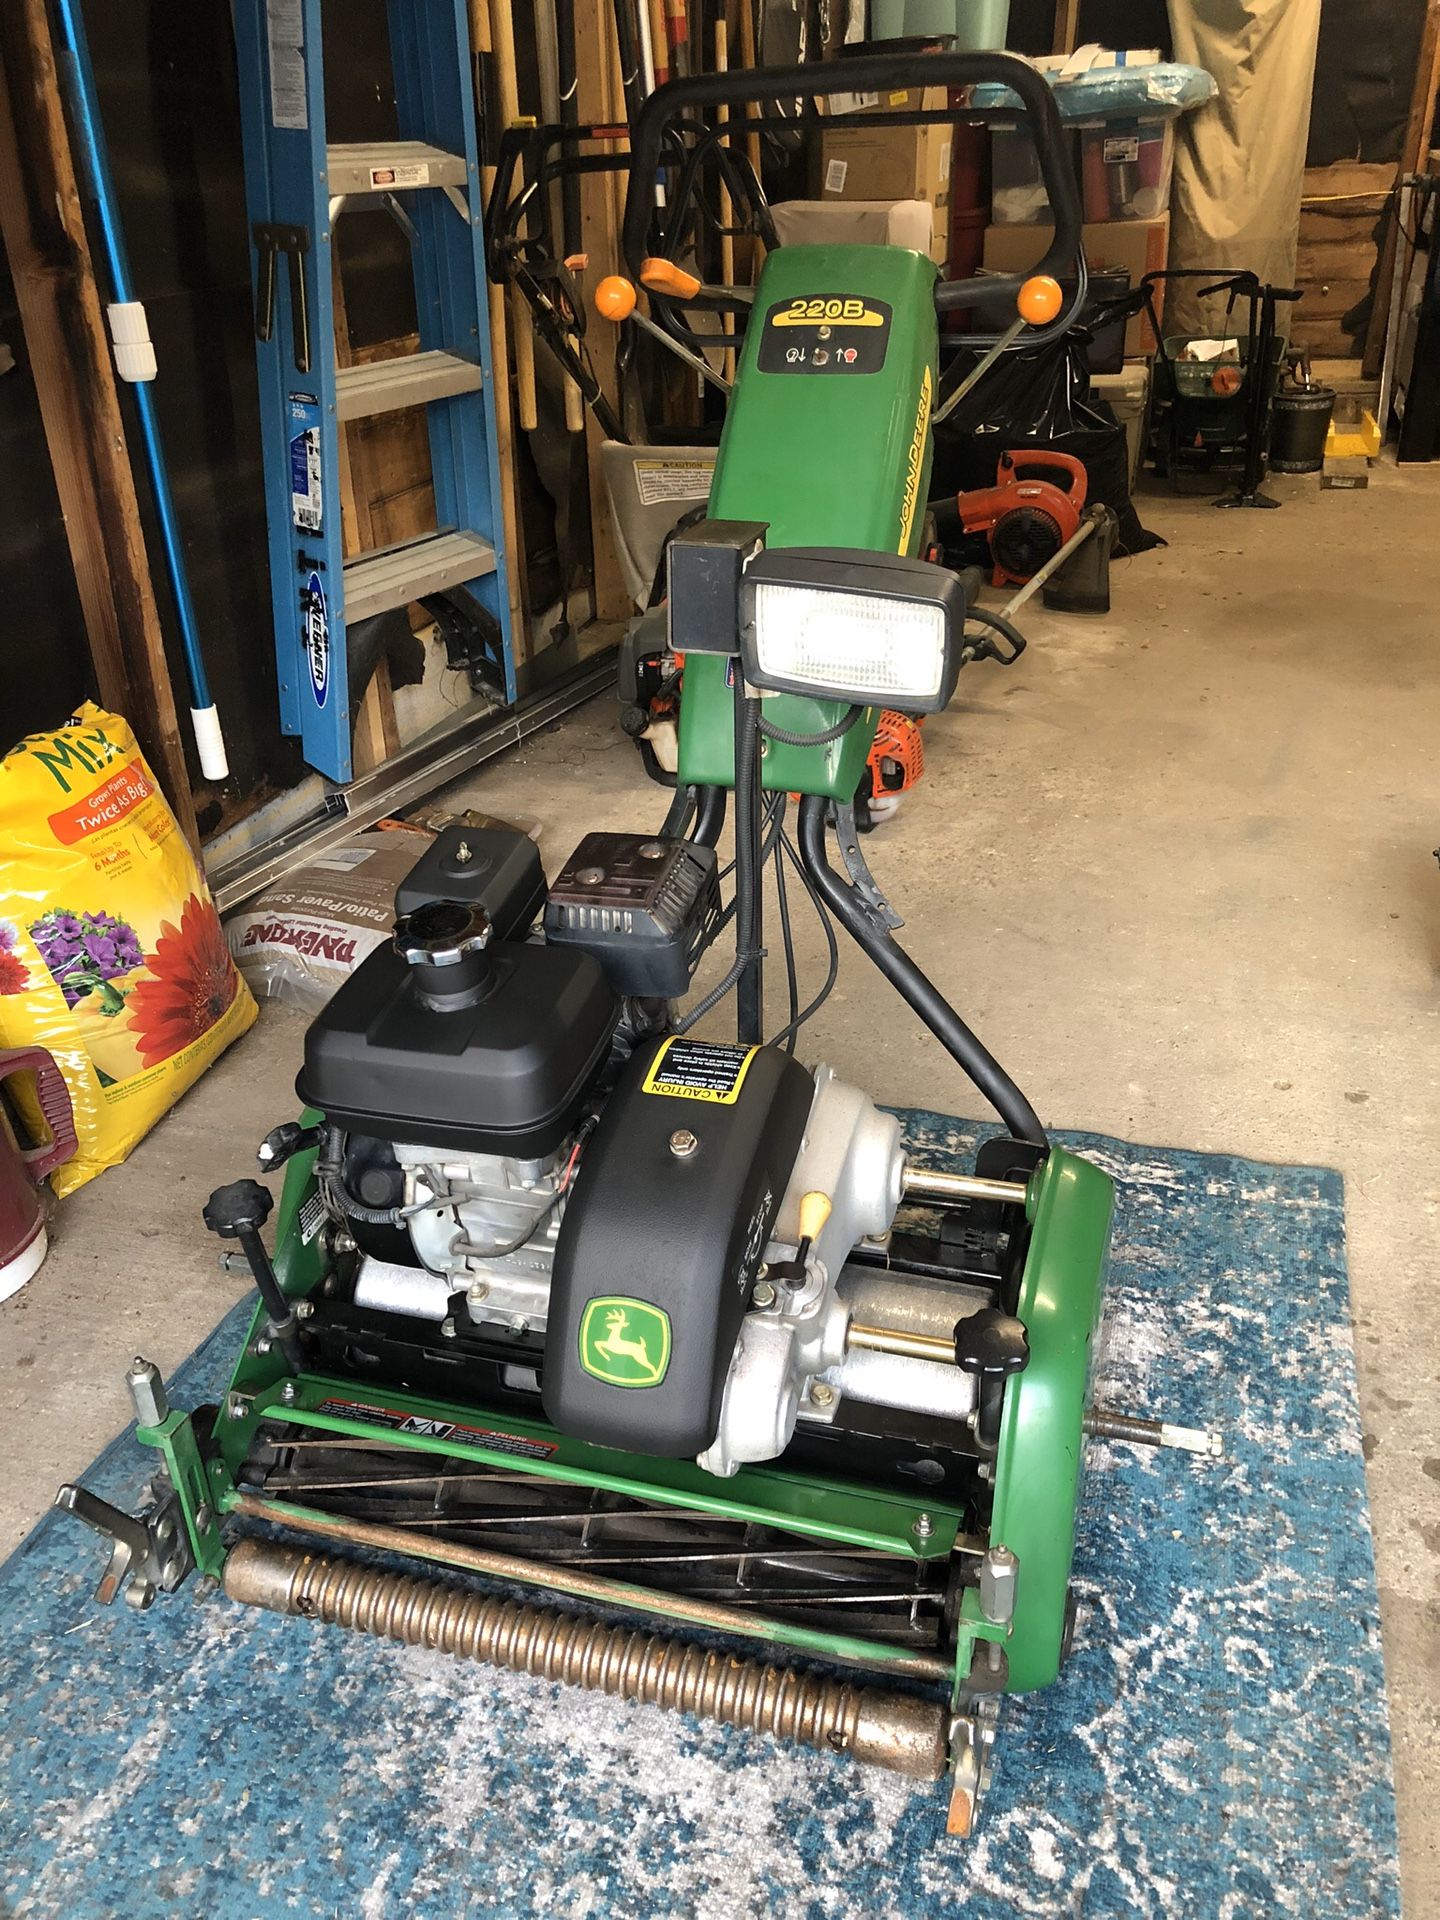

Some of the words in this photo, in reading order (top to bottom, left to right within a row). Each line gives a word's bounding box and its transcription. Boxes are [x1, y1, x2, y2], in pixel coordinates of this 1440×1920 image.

[788, 299, 865, 319] 220B
[291, 408, 306, 419] 250
[900, 464, 918, 539] JOHN
[909, 384, 929, 468] DEERE
[88, 787, 112, 809] Grows
[107, 776, 128, 797] Plants
[75, 803, 121, 831] Twice
[117, 795, 130, 809] As
[127, 777, 149, 800] Big!
[94, 859, 102, 871] 6
[296, 896, 389, 923] Patio/Paver
[658, 1076, 684, 1084] INJURY
[650, 1083, 712, 1098] CAUTION
